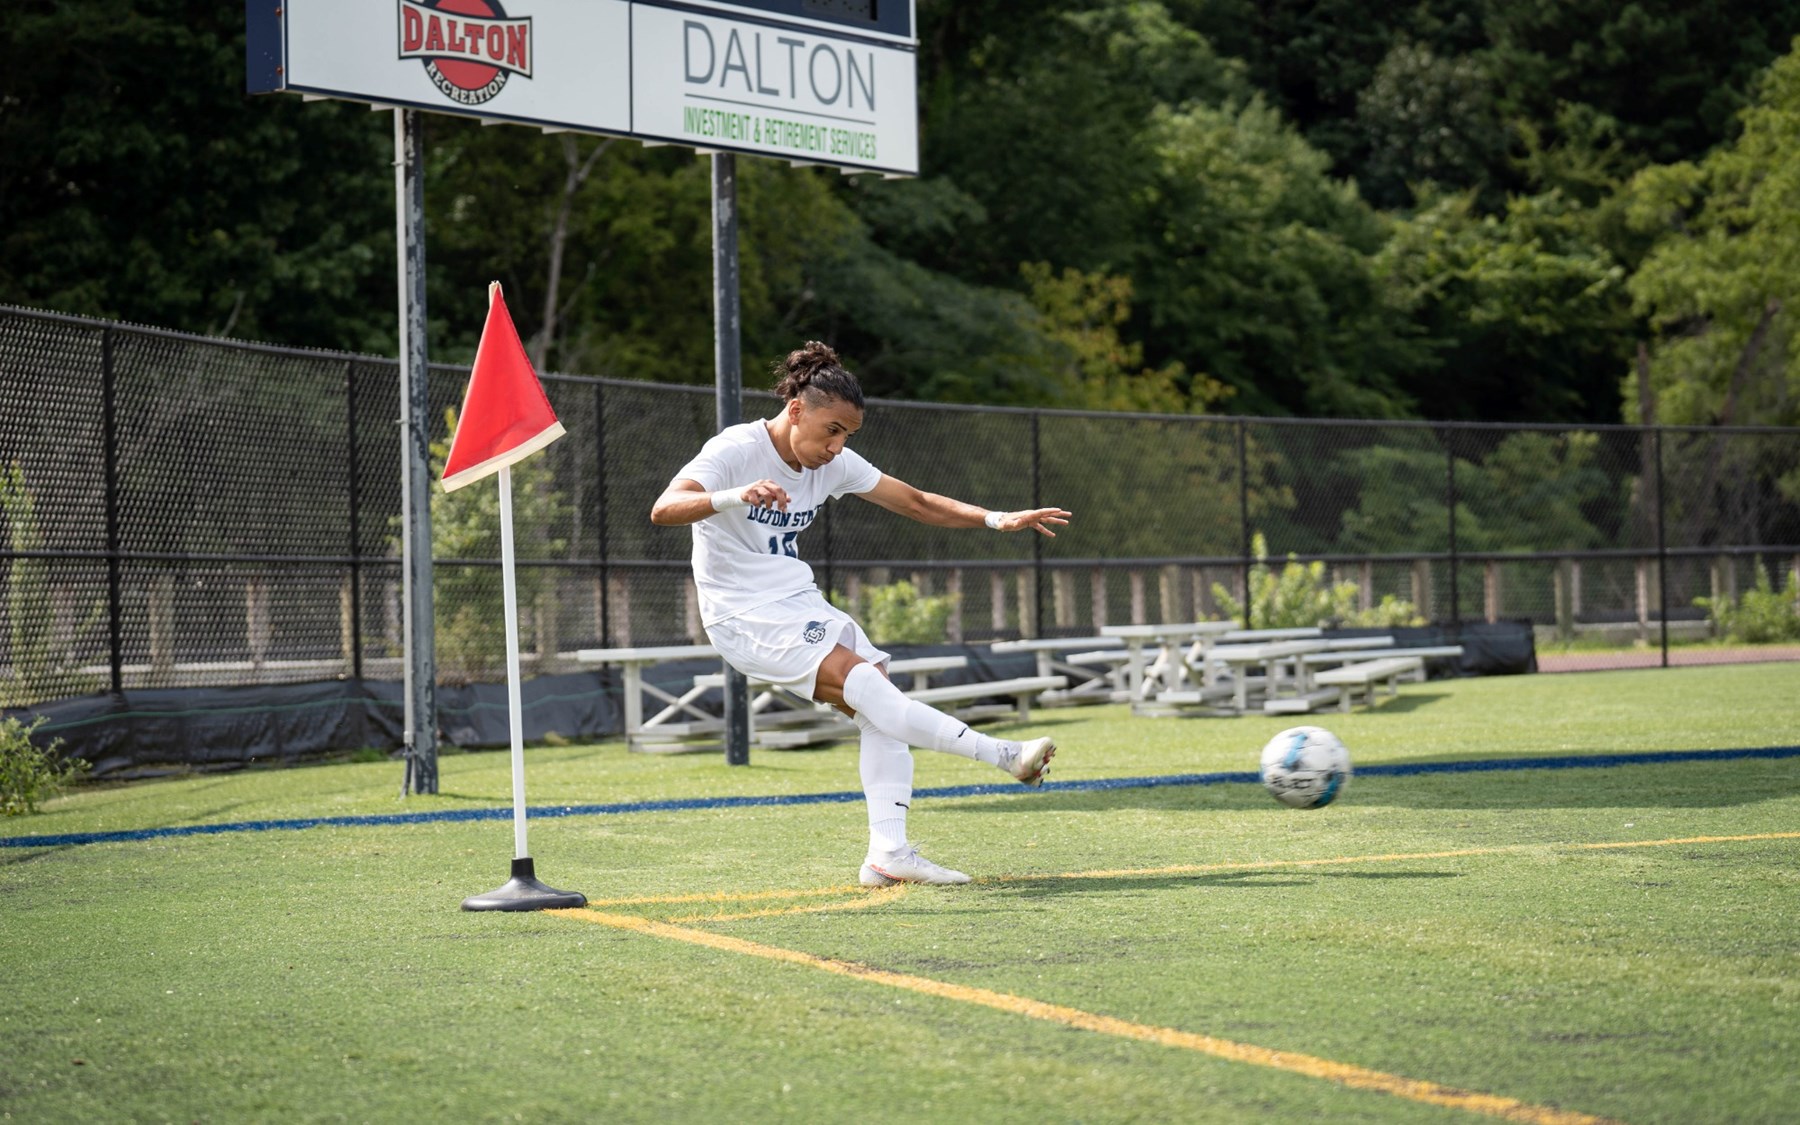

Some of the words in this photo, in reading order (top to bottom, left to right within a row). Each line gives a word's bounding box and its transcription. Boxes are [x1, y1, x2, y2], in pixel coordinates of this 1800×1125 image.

[402, 4, 527, 70] DALTON
[684, 20, 875, 112] DALTON
[427, 61, 506, 103] RECREATION
[684, 106, 751, 141] INVESTMENT
[753, 117, 761, 143] &
[765, 118, 828, 151] RETIREMENT
[830, 128, 877, 160] SERVICES
